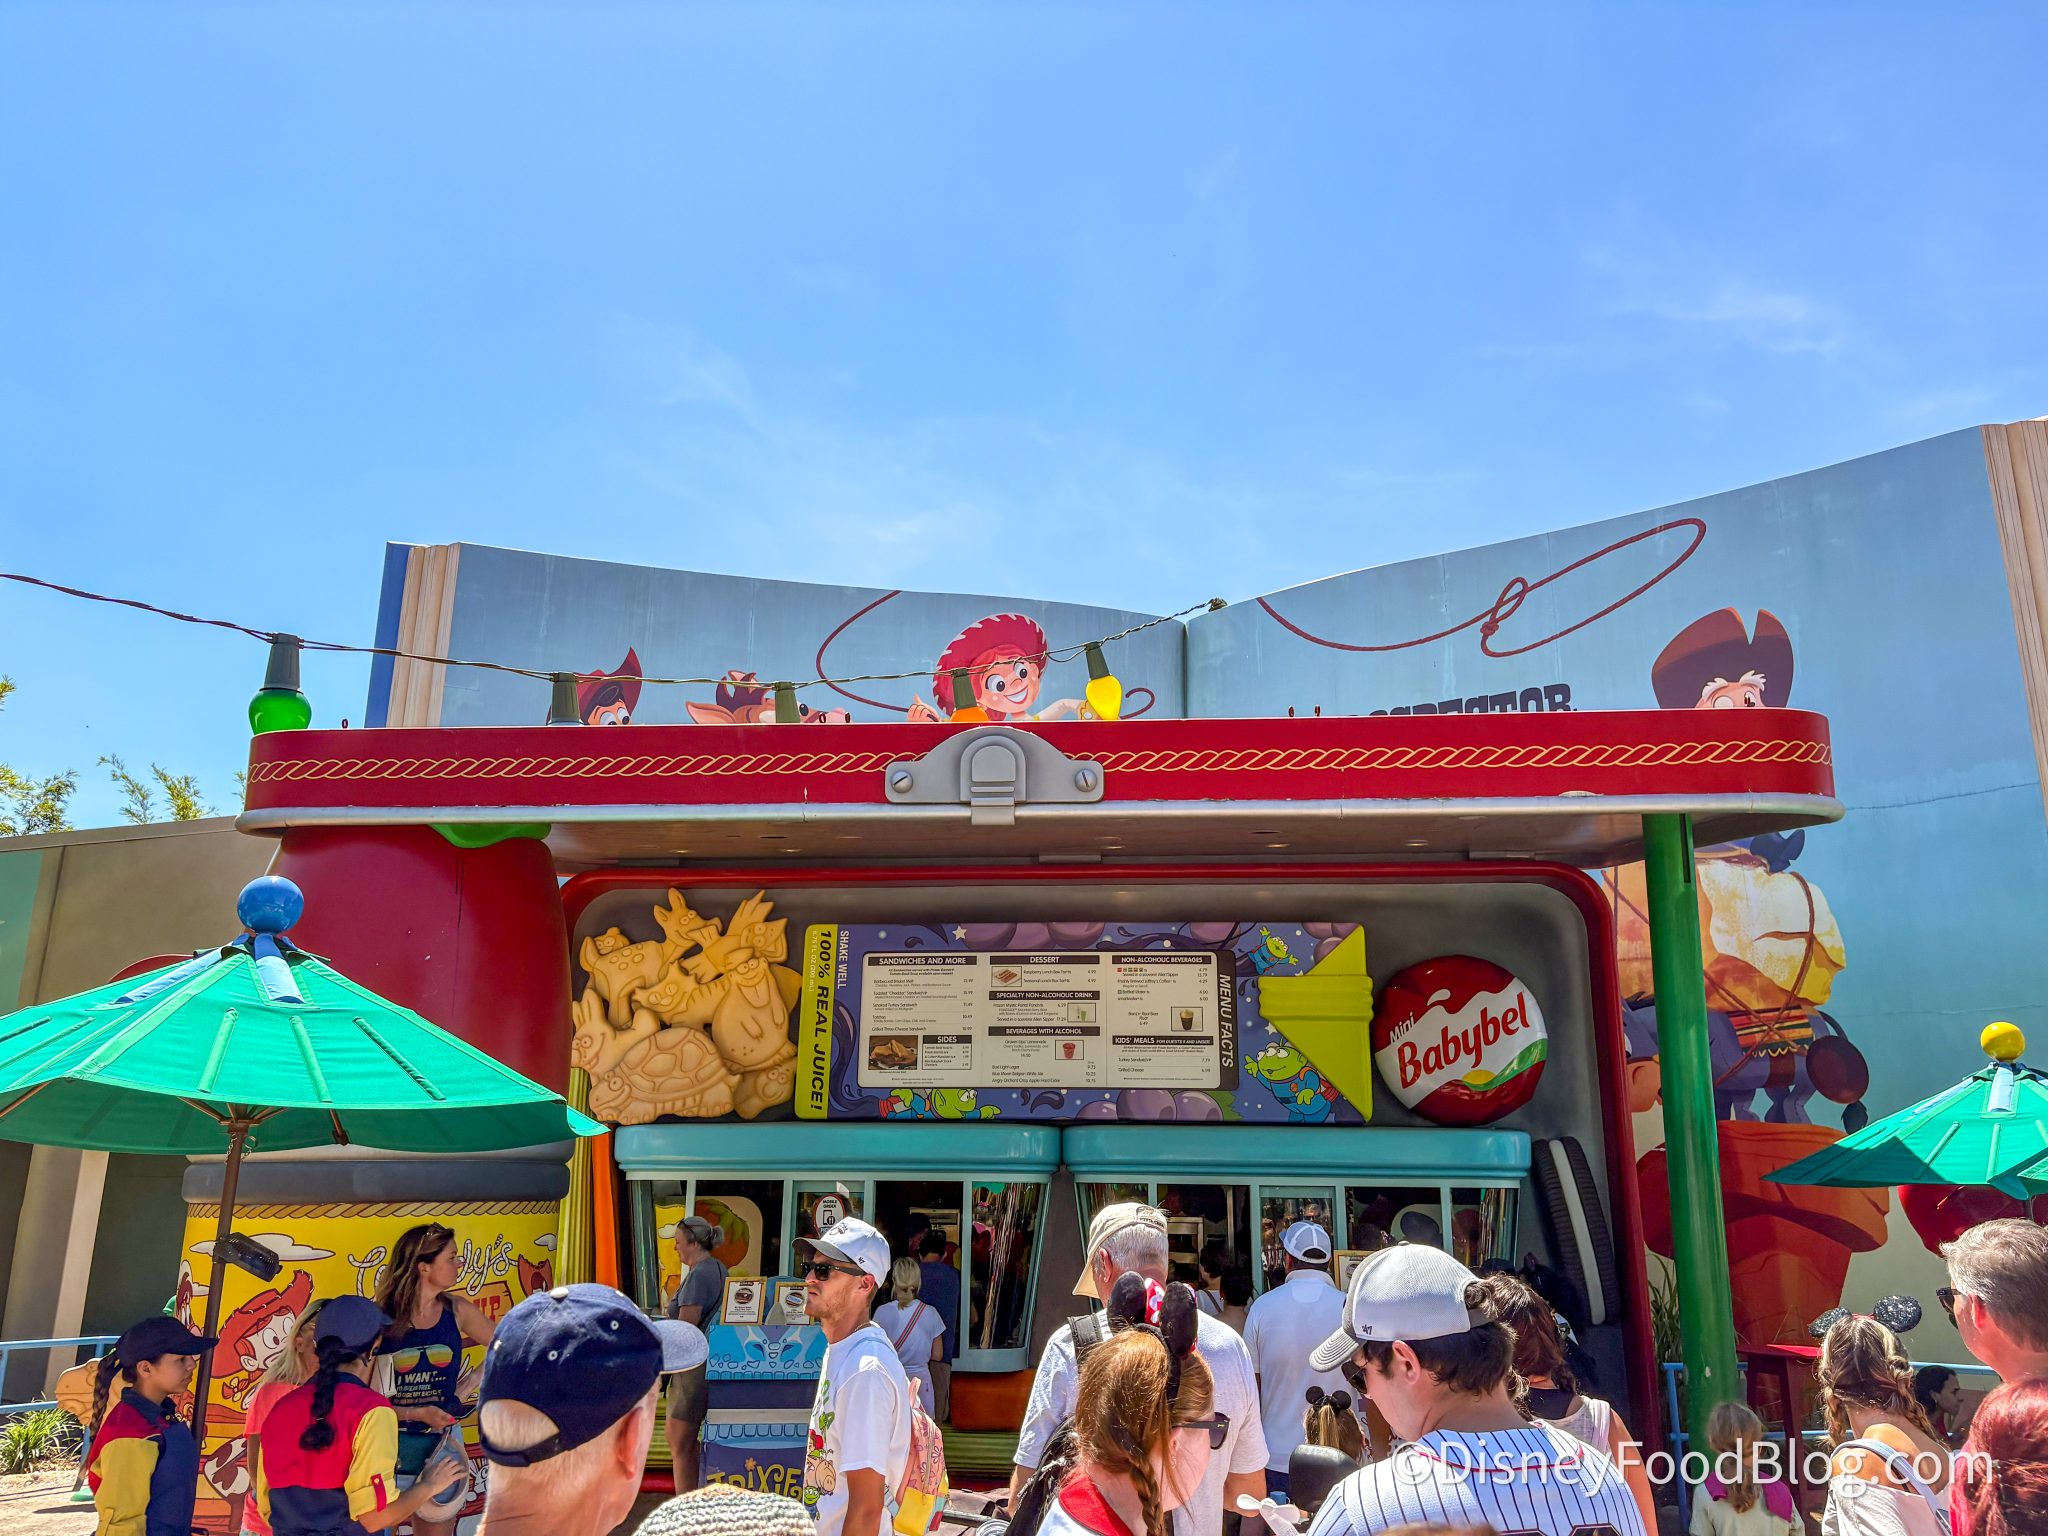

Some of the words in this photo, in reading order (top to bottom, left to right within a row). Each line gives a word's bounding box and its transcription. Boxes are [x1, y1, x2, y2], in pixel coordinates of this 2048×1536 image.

[818, 930, 832, 979] 100%
[838, 930, 849, 961] SHAKE
[837, 963, 848, 990] WELL
[1219, 974, 1232, 1019] MENU
[814, 985, 829, 1038] REAL
[1390, 1012, 1415, 1043] Mini
[1220, 1022, 1234, 1068] FACTS
[1397, 991, 1530, 1090] Babybel
[810, 1043, 826, 1111] JUICE!
[397, 1376, 402, 1385] I
